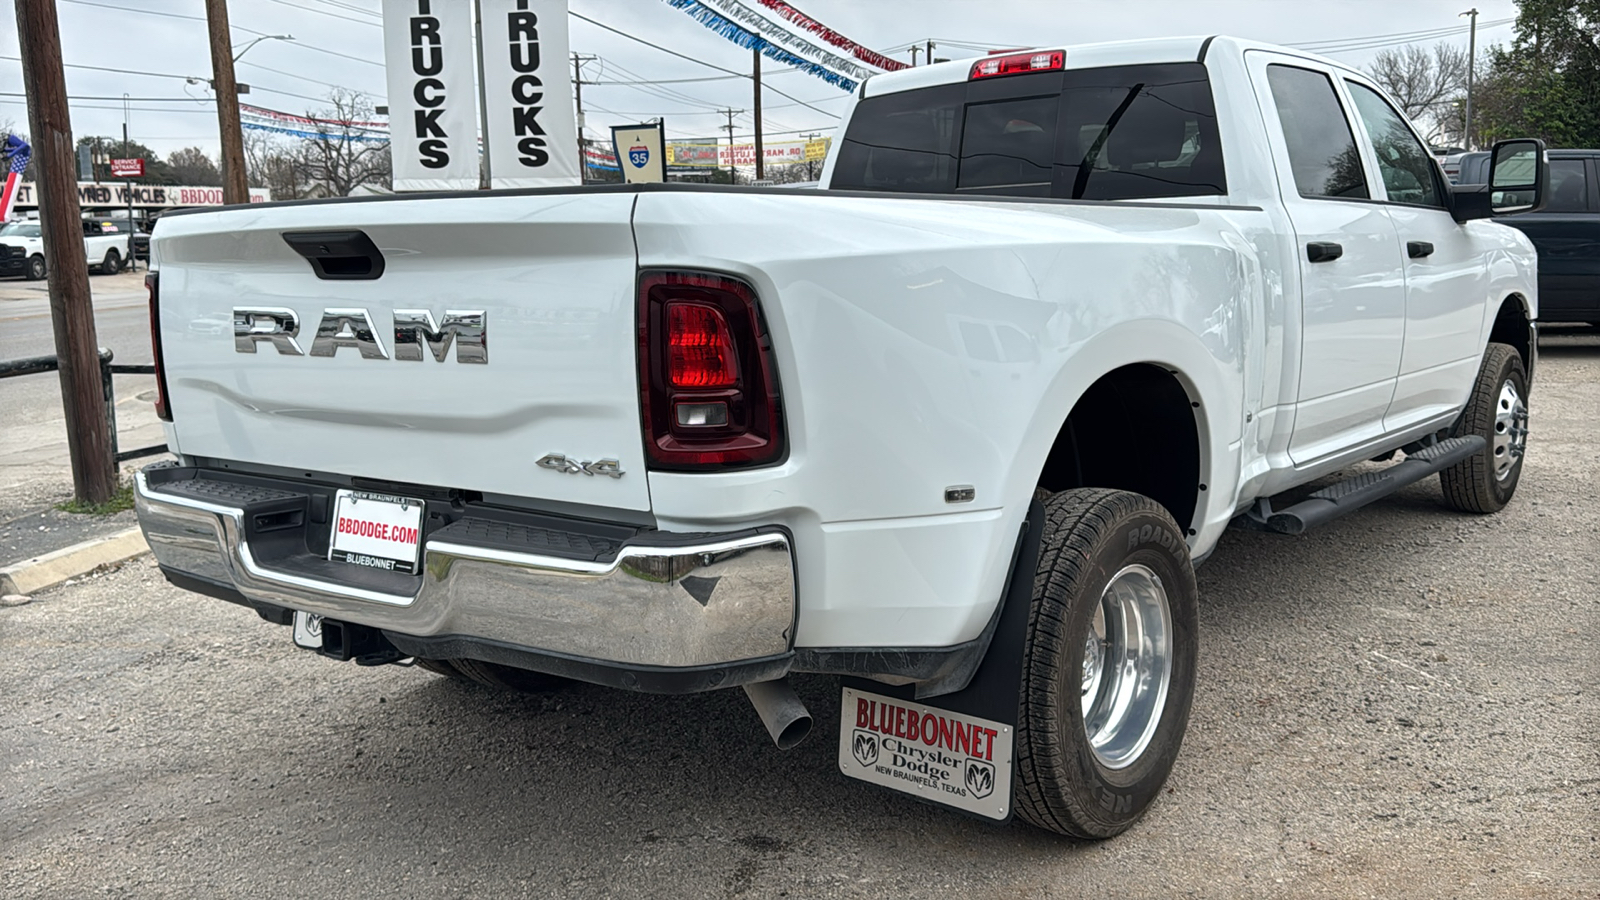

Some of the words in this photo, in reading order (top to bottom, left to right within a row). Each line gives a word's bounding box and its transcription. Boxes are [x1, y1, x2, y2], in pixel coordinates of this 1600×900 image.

[632, 153, 647, 164] 35
[115, 188, 166, 204] VEHICLES
[232, 306, 489, 364] RAM
[368, 494, 405, 503] BRAUNFELS
[338, 517, 418, 545] BBDODGE.COM
[346, 553, 396, 570] BLUEBONNET
[856, 698, 998, 761] BLUEBONNET
[881, 738, 962, 769] Chrysler
[875, 765, 893, 775] NEW
[893, 770, 940, 791] BRAUNFELS,
[941, 783, 967, 797] TEXAS
[892, 754, 950, 781] Dodge
